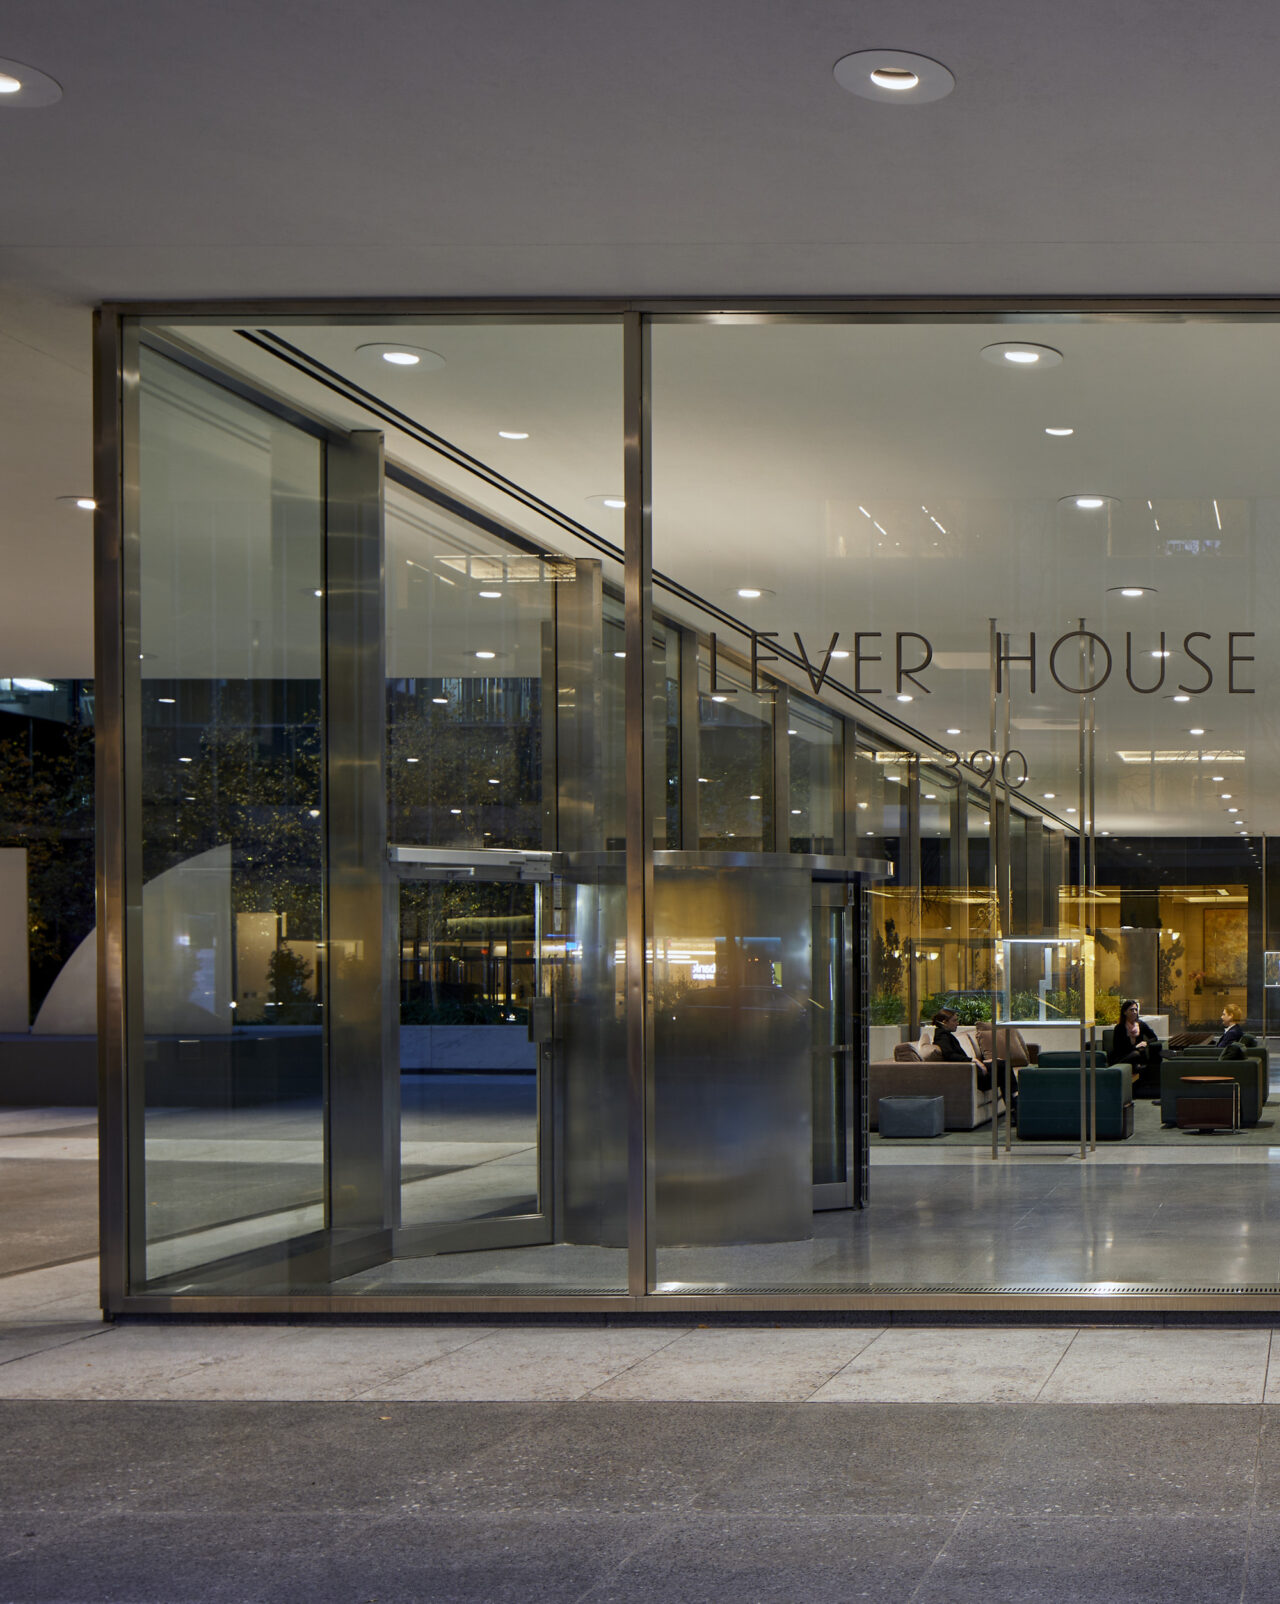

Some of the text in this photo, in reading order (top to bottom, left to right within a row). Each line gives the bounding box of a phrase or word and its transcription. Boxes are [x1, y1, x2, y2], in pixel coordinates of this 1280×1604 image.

[709, 631, 1256, 695] LEVER HOUSE
[939, 749, 1028, 789] 390
